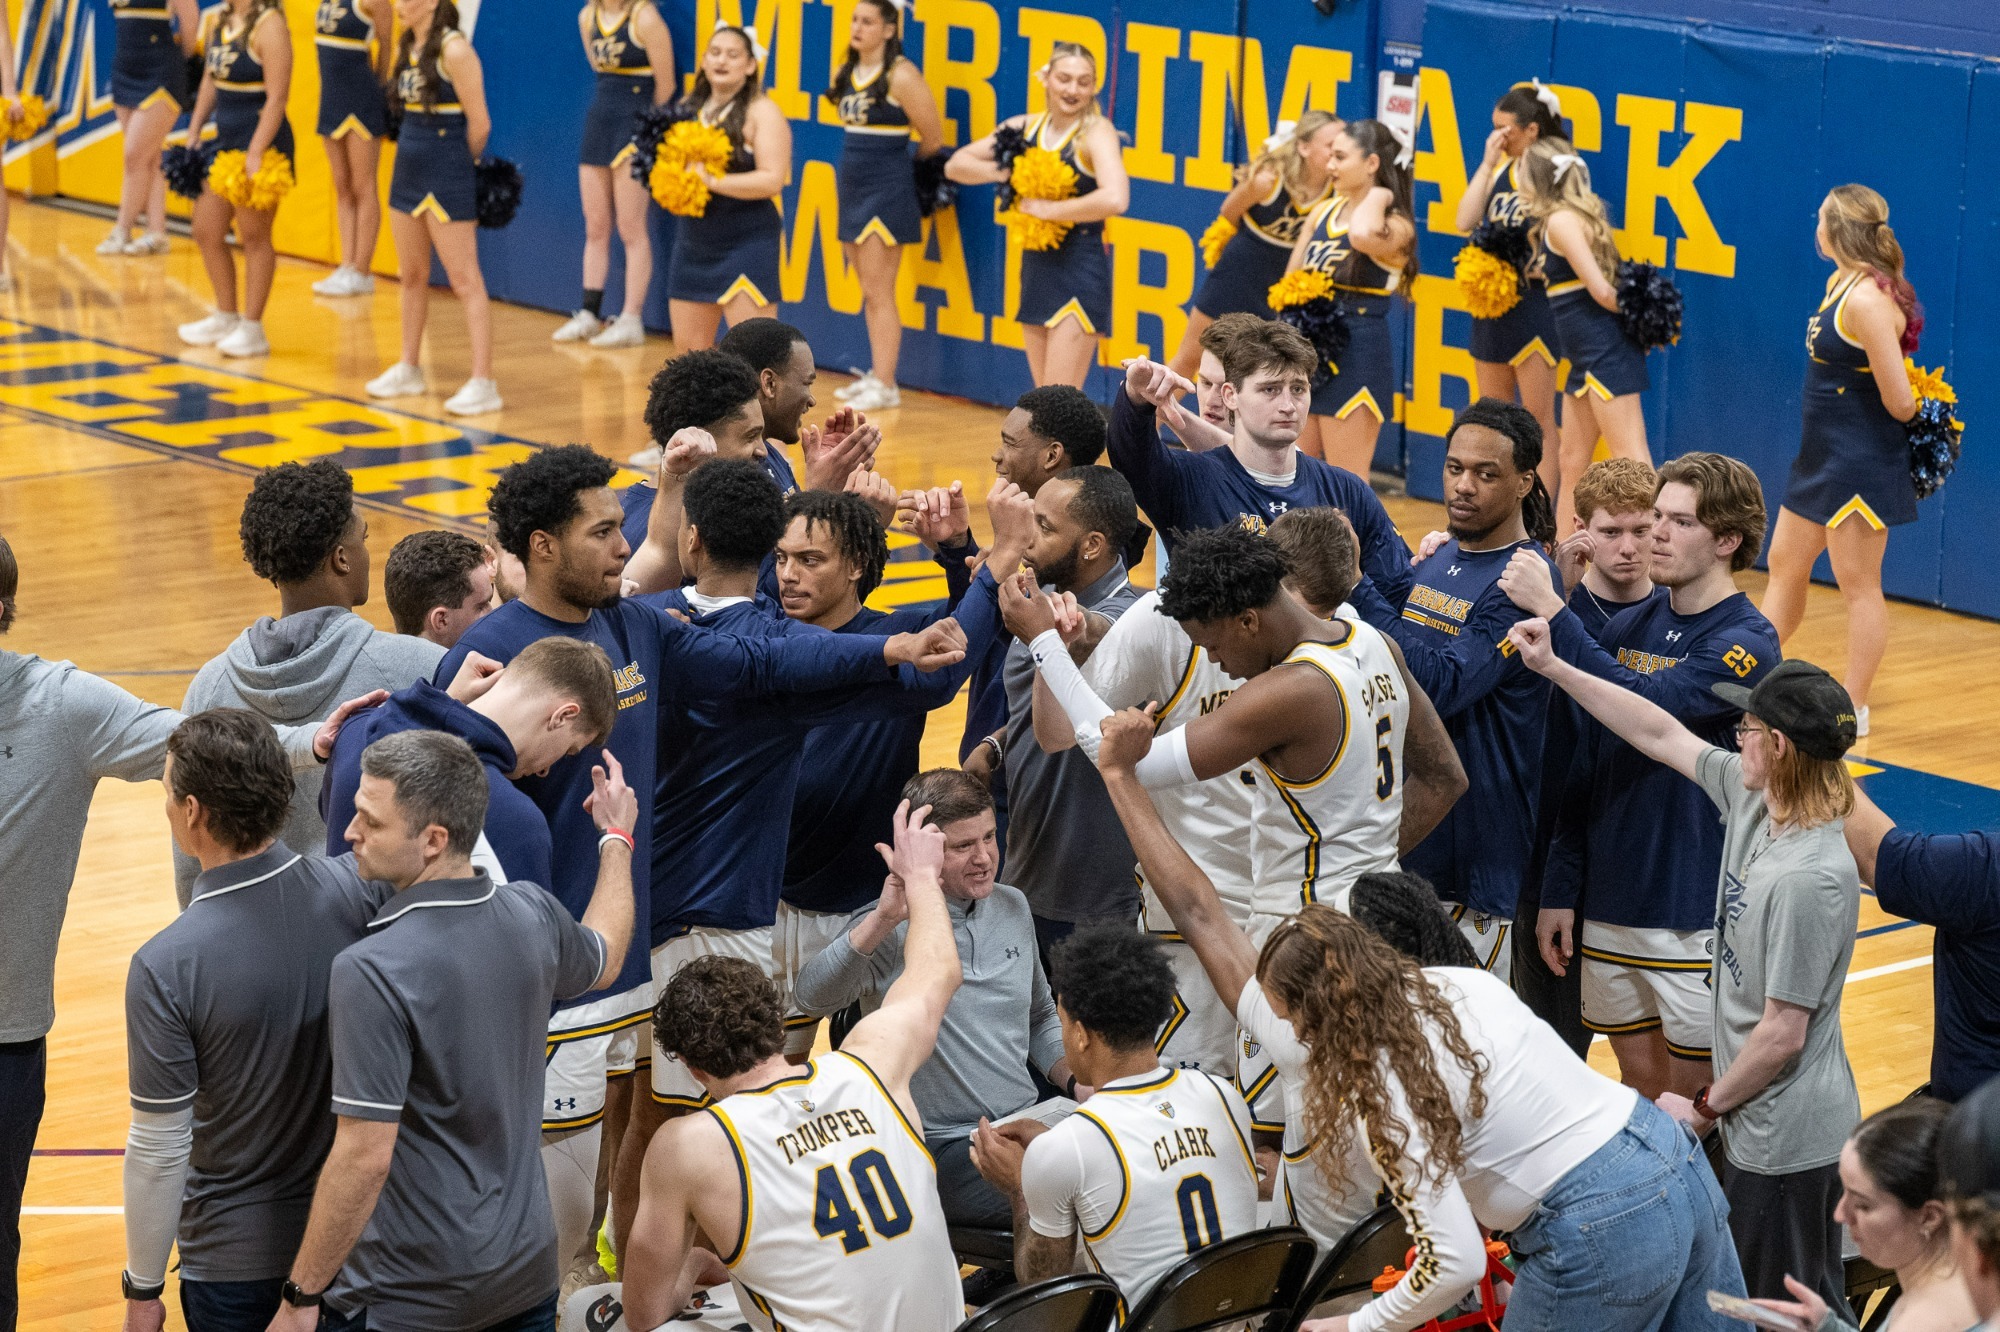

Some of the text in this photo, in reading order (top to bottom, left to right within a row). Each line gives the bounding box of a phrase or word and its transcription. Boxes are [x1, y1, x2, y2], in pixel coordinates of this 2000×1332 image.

[684, 0, 1743, 278] MRRIMAK
[1722, 644, 1758, 678] 25
[1375, 713, 1396, 803] 5
[776, 1108, 877, 1166] TRUMPER
[1153, 1126, 1217, 1172] CLARK
[811, 1146, 916, 1257] 40
[1174, 1171, 1225, 1257] 0
